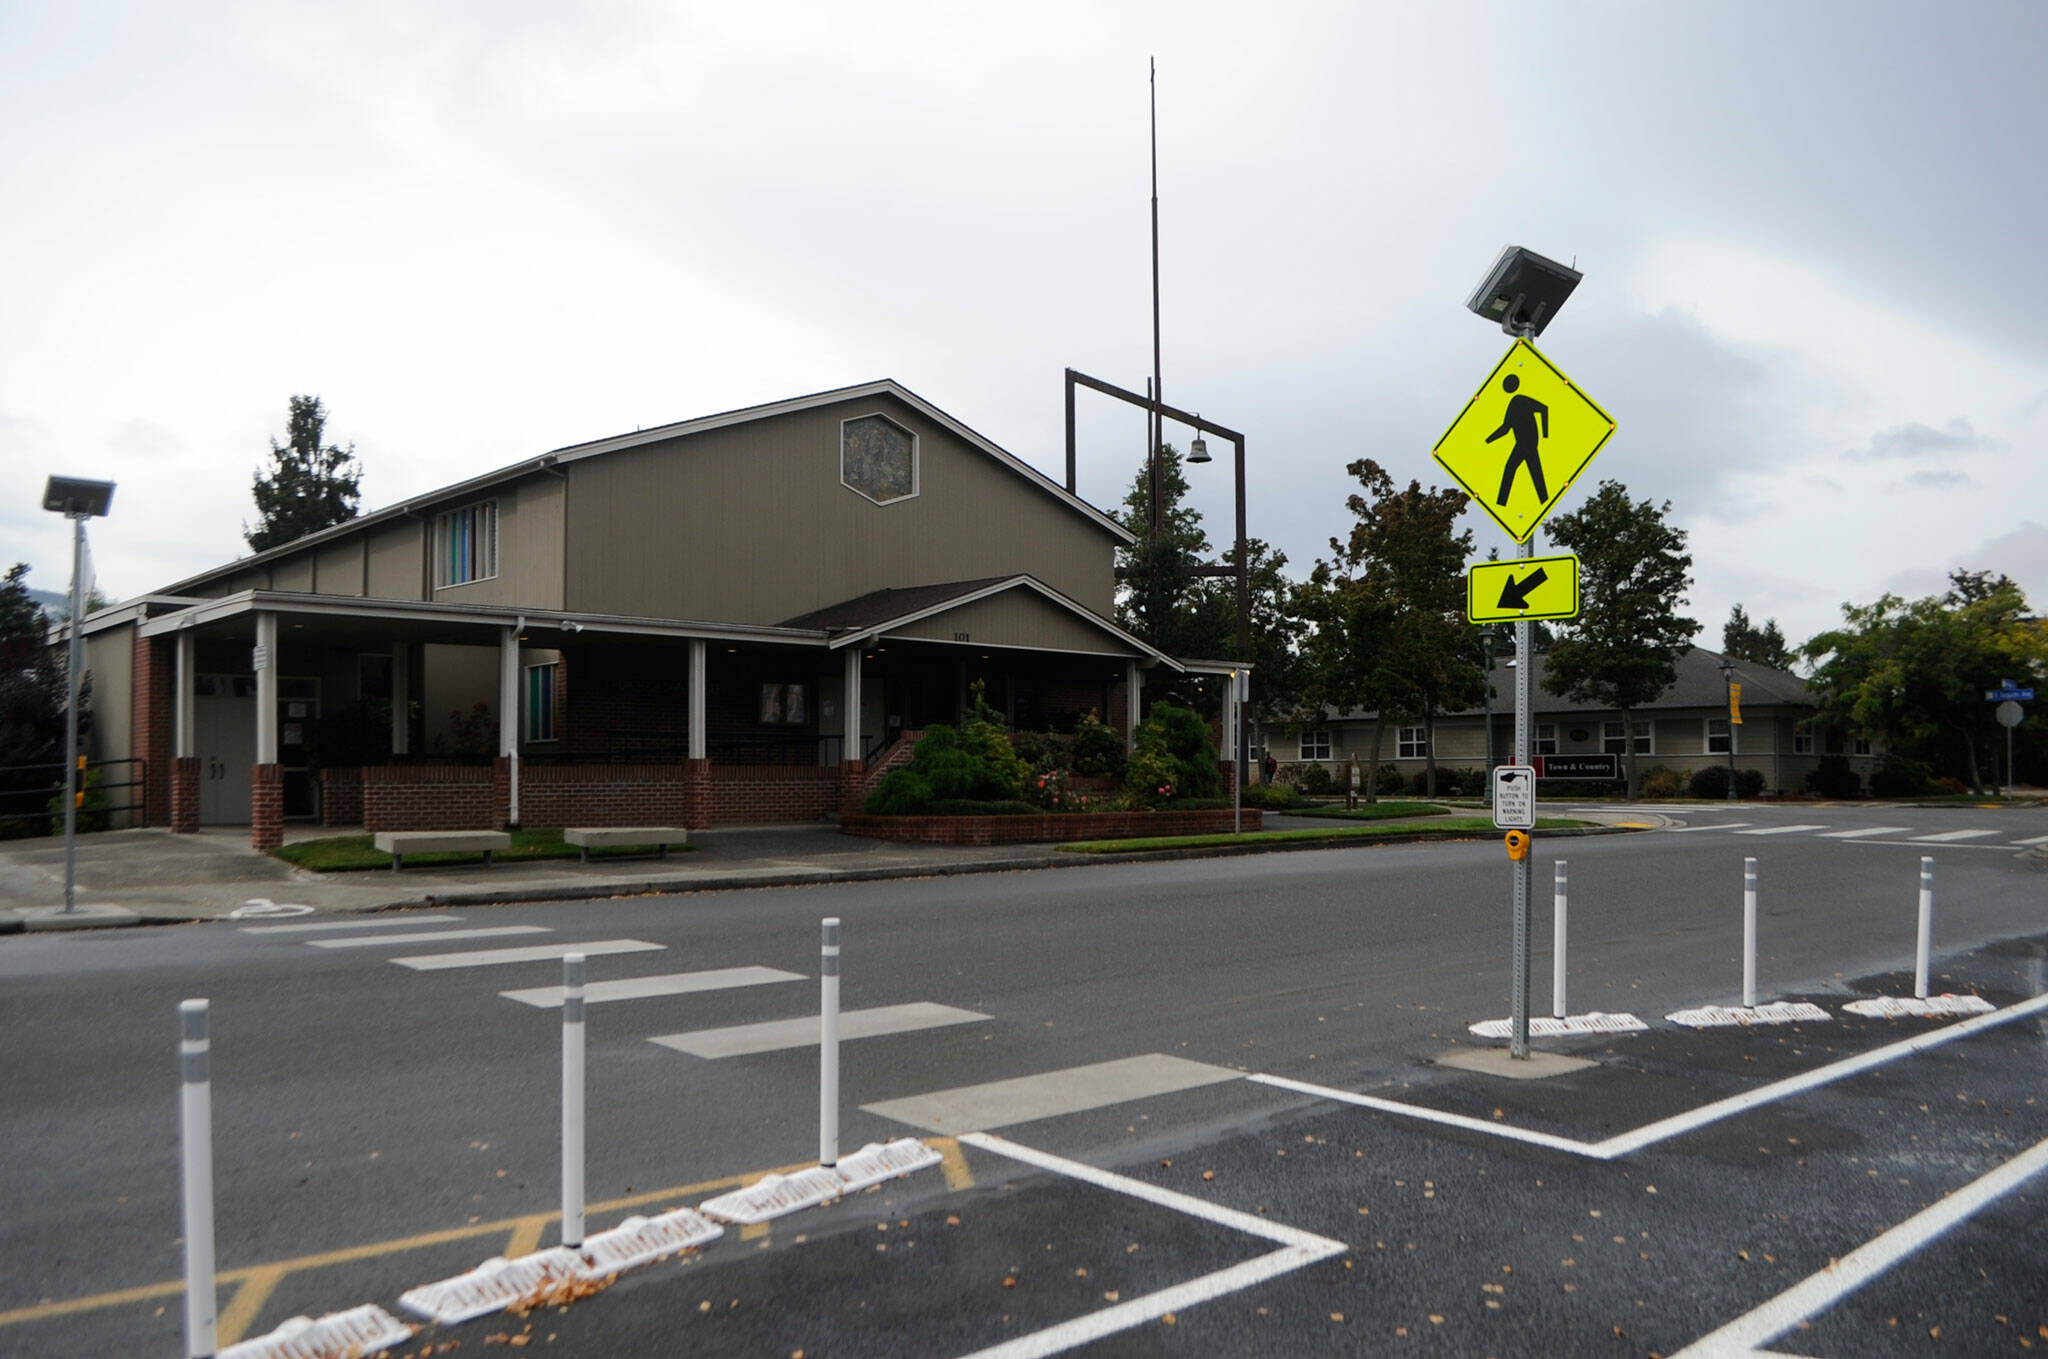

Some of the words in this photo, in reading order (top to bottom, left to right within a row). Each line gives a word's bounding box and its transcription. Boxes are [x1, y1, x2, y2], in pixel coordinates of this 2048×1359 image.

[954, 631, 969, 642] 101
[1548, 763, 1568, 771] Town
[1569, 763, 1577, 771] &
[1579, 763, 1610, 772] Country
